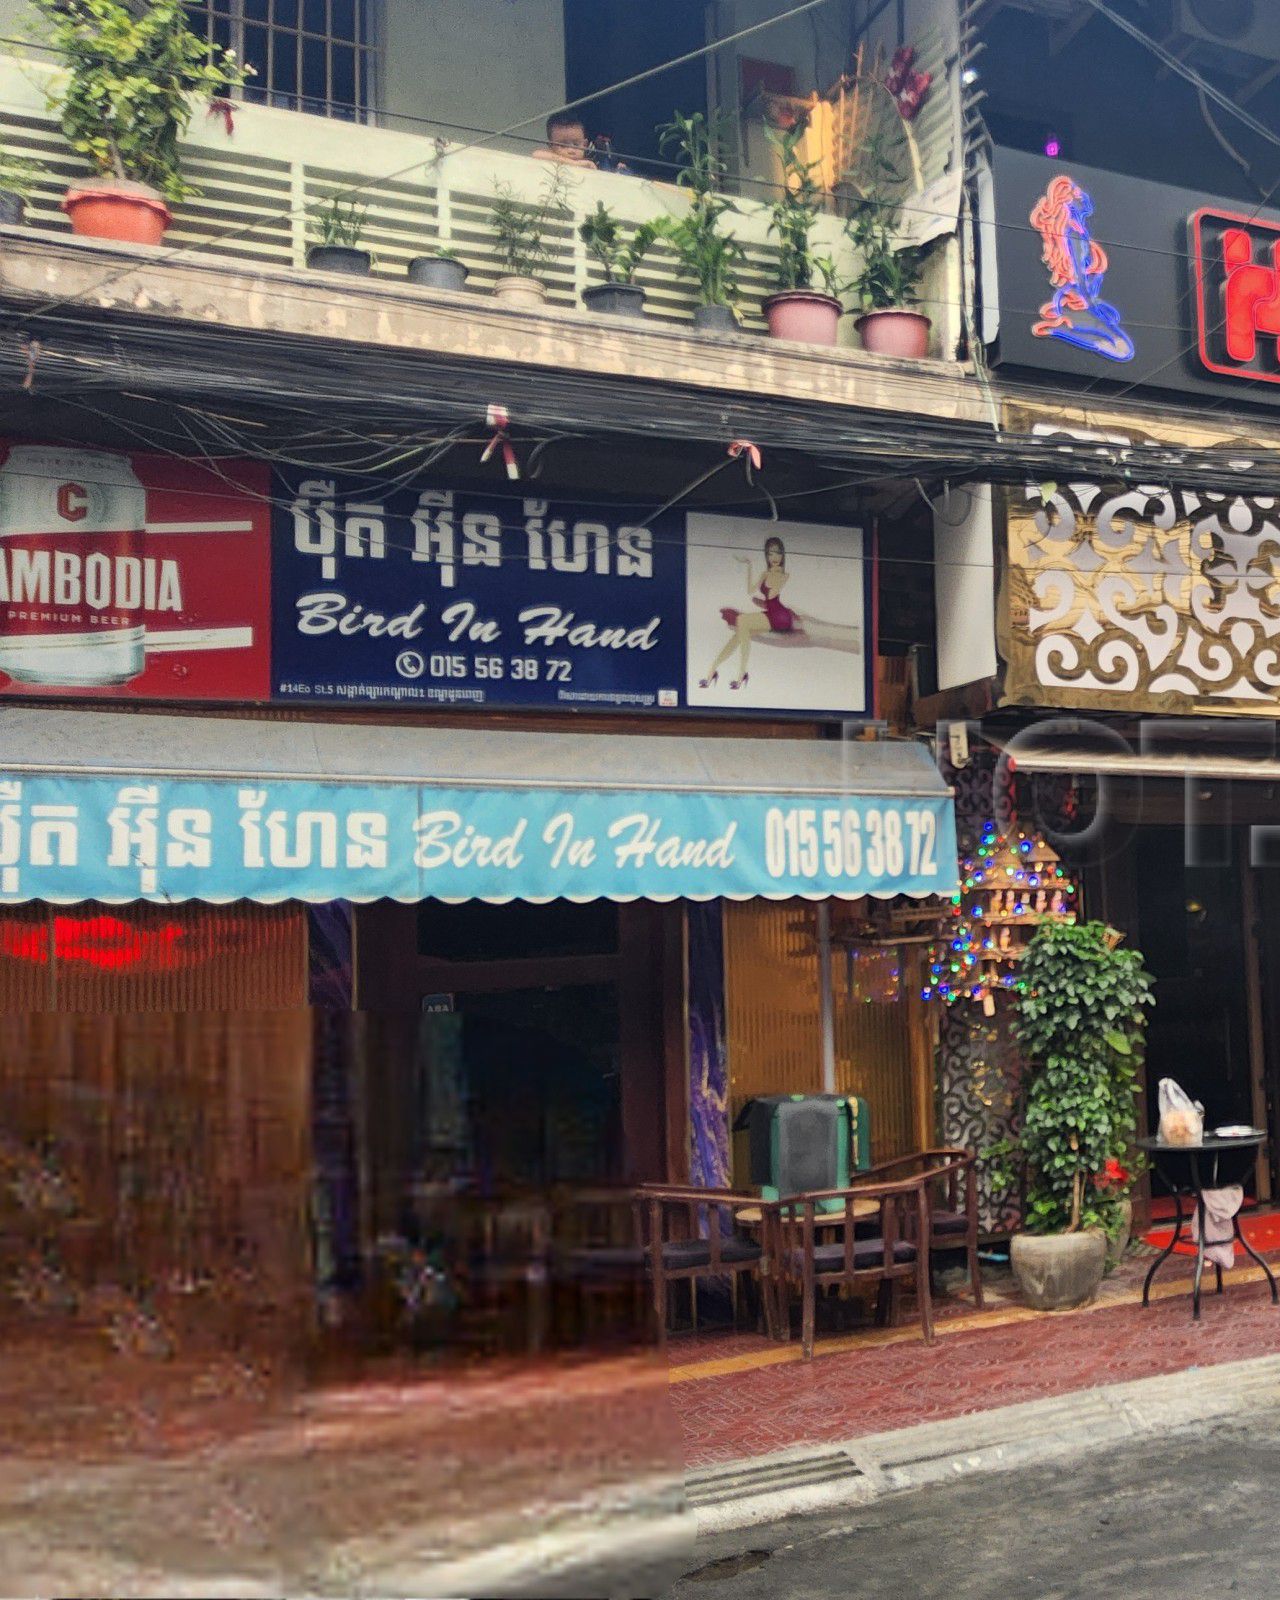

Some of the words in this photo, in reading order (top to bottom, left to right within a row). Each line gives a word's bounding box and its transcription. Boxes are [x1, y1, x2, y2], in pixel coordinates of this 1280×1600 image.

[8, 611, 82, 624] PREMIUM
[90, 615, 130, 626] BEER
[296, 592, 425, 638] Bird
[441, 602, 501, 643] In
[518, 606, 660, 650] Hand
[430, 655, 466, 678] 015
[474, 656, 503, 679] 56
[510, 658, 538, 680] 38
[546, 660, 572, 682] 72
[413, 811, 528, 869] Bird
[543, 812, 597, 869] In
[607, 813, 738, 869] Hand
[765, 808, 818, 877] 015
[822, 808, 862, 877] 56
[866, 809, 904, 877] 38
[905, 809, 938, 876] 72
